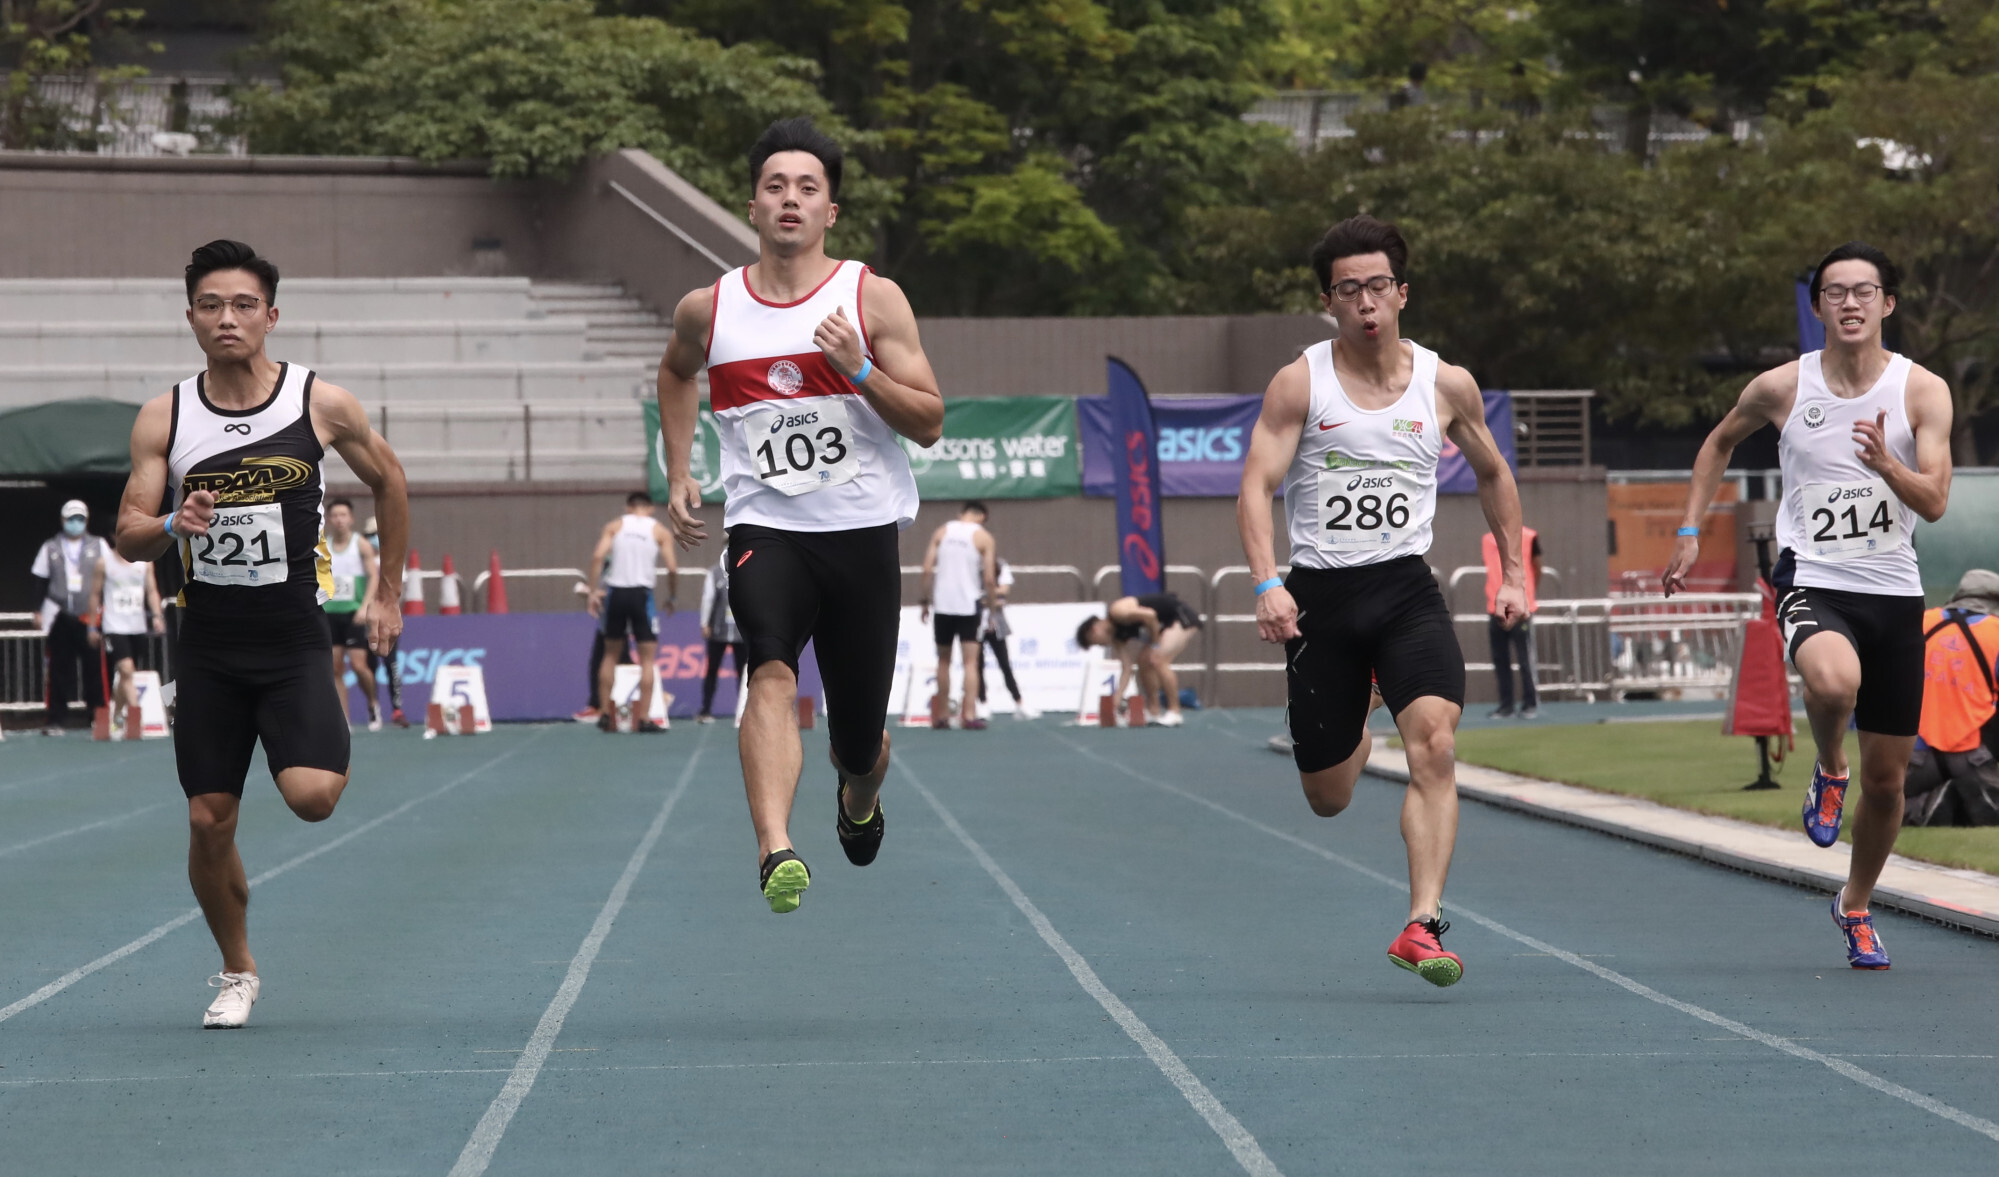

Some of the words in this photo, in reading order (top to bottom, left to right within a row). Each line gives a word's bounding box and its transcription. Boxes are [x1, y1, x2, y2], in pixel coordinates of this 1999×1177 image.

[786, 411, 819, 428] asics
[757, 427, 847, 480] 103
[1001, 432, 1069, 458] water
[1157, 427, 1243, 462] asics
[1126, 431, 1153, 531] asics
[1362, 477, 1394, 489] asics
[1843, 487, 1873, 499] asics
[221, 514, 254, 526] asics
[1325, 492, 1410, 531] 286
[1812, 500, 1894, 542] 214
[194, 530, 281, 566] 221
[451, 680, 470, 706] 5
